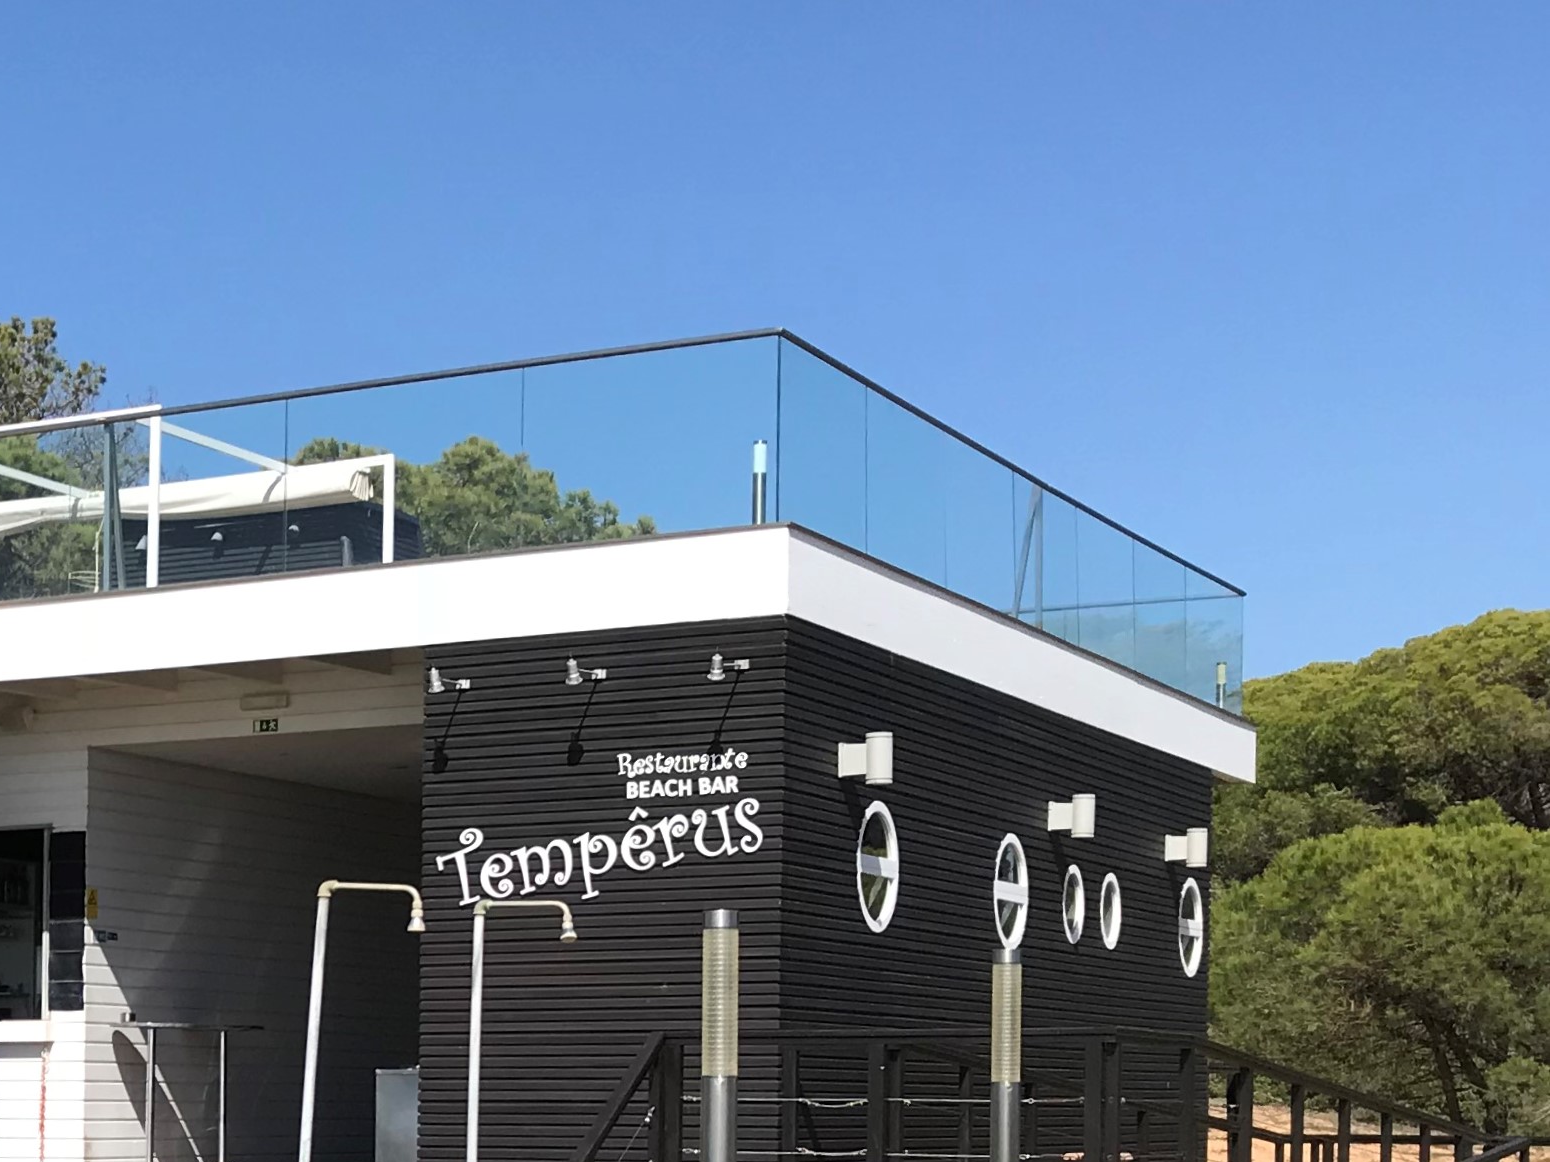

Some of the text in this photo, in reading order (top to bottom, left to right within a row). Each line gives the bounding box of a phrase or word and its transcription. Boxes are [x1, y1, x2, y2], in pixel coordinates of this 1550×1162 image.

[617, 748, 749, 778] Restaurante
[626, 775, 739, 799] BEACH BAR
[435, 798, 764, 907] Tempêrus
